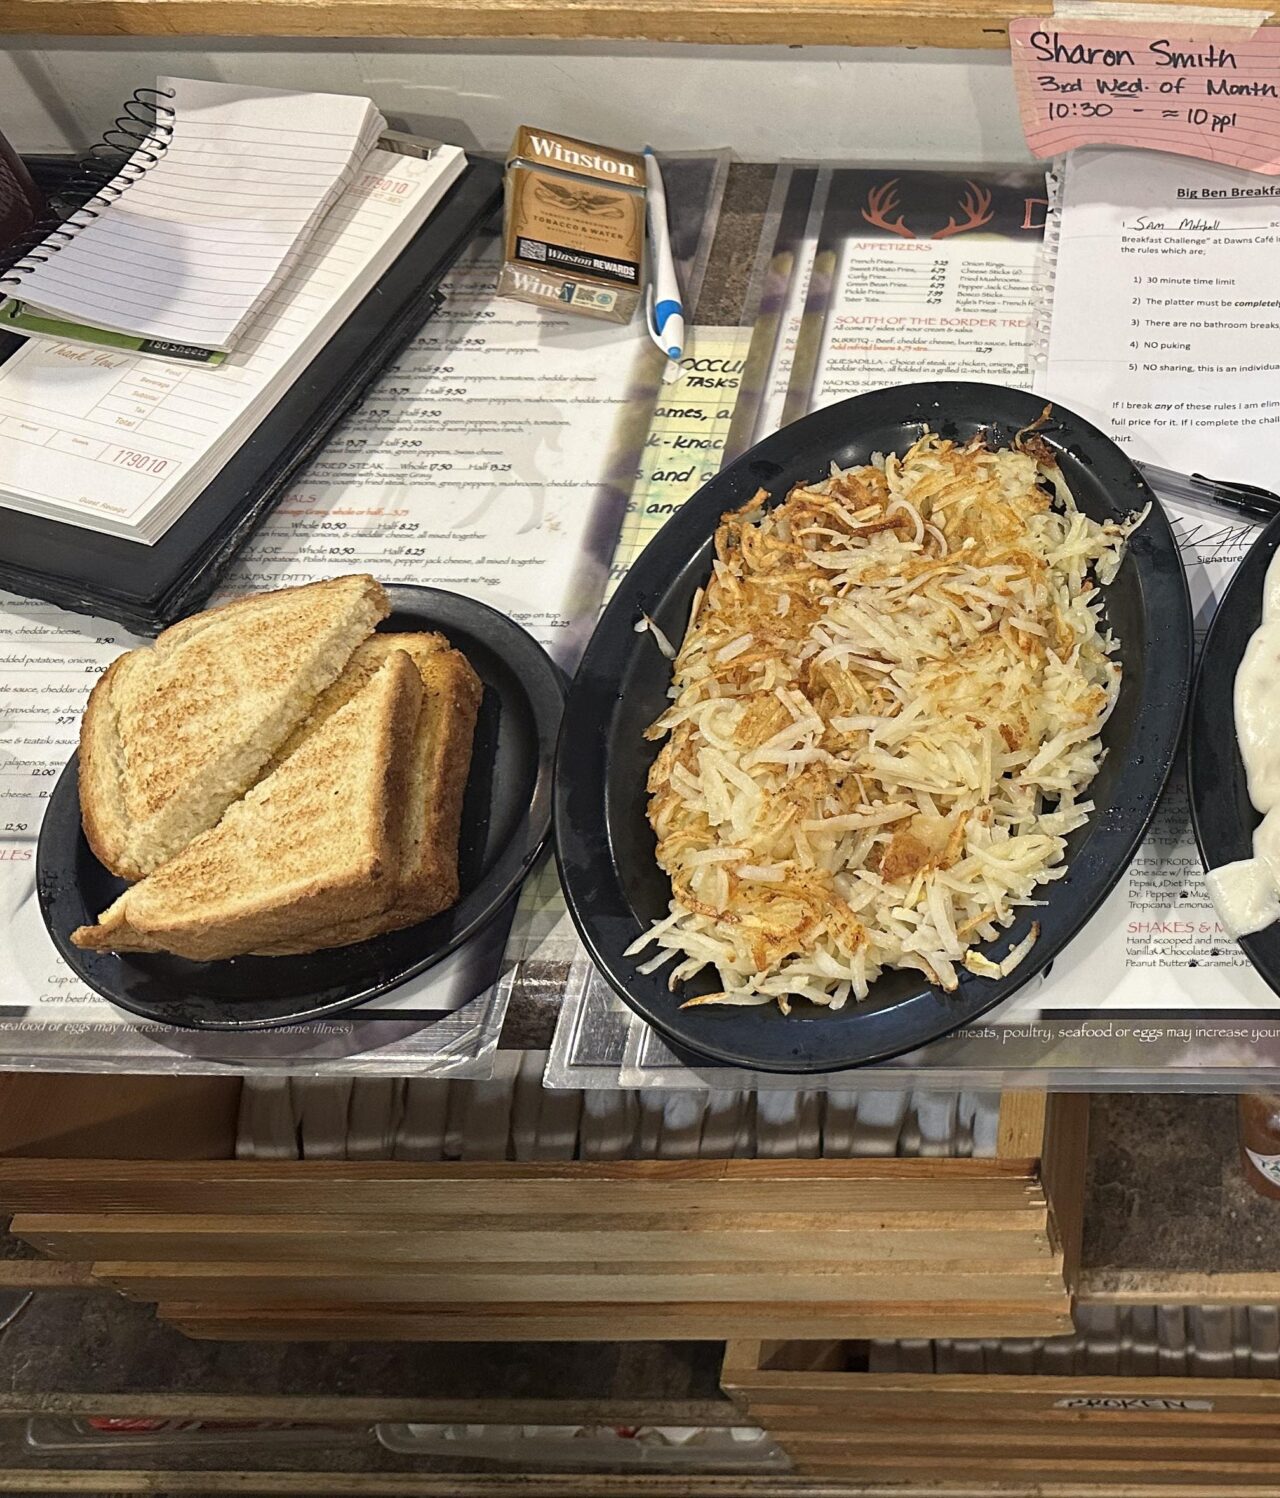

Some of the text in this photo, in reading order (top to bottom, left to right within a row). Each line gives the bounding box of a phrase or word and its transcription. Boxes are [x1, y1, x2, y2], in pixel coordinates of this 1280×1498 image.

[1030, 31, 1237, 69] Sharon Smith
[1037, 76, 1278, 98] 3rd Wed. of Month
[1048, 102, 1113, 121] 10:30
[529, 135, 637, 179] Winston
[361, 175, 409, 194] 179010
[1176, 188, 1199, 199] Big
[1201, 187, 1228, 198] Ben
[533, 215, 579, 231] TOBACCO
[589, 228, 624, 240] WATER
[854, 242, 933, 251] APPETIZERS
[1121, 236, 1162, 245] Breakfast
[1164, 236, 1211, 246] Challenge"
[1254, 235, 1274, 243] Café
[547, 248, 635, 276] Winston REWARDS
[512, 271, 564, 299] Wins
[1133, 276, 1142, 284] 1)
[1131, 297, 1140, 305] 2)
[1146, 297, 1162, 305] The
[1164, 298, 1194, 306] platter
[834, 316, 997, 327] SOUTH OF THE BORDER
[1129, 340, 1138, 349] 4)
[1160, 342, 1190, 350] puking
[686, 376, 740, 388] TASKS
[112, 450, 168, 473] 179010
[651, 466, 696, 482] and
[1197, 555, 1243, 565] Signature
[1127, 921, 1211, 933] SHAKES &
[957, 1026, 1000, 1040] meats,
[1002, 1023, 1054, 1044] poultry,
[1057, 1023, 1112, 1038] seafood
[1115, 1028, 1131, 1038] or
[1133, 1028, 1163, 1042] eggs
[1166, 1028, 1192, 1042] may
[1195, 1025, 1249, 1038] increase
